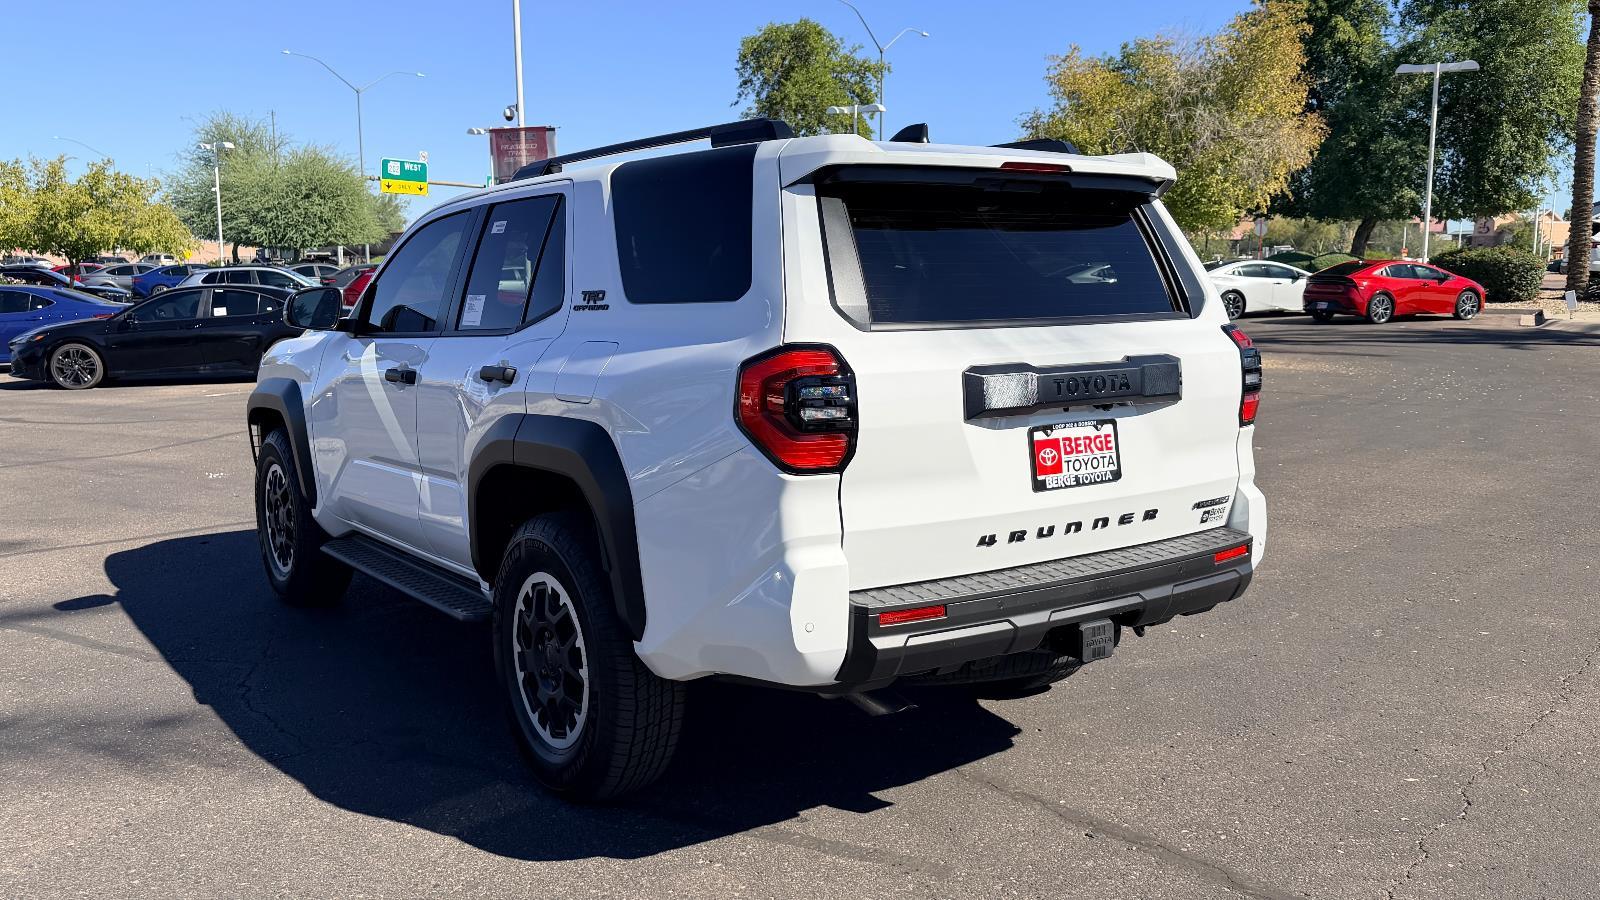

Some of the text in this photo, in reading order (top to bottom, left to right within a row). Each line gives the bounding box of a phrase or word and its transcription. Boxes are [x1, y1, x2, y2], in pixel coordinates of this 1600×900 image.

[404, 162, 422, 172] WEST
[582, 290, 606, 304] TRD
[1053, 373, 1131, 396] TOYOTA
[1062, 434, 1114, 454] BERGE
[1064, 455, 1116, 472] TOYOTA
[1046, 471, 1112, 488] BERGE TOYOTA
[1086, 636, 1113, 648] TOYOTA
